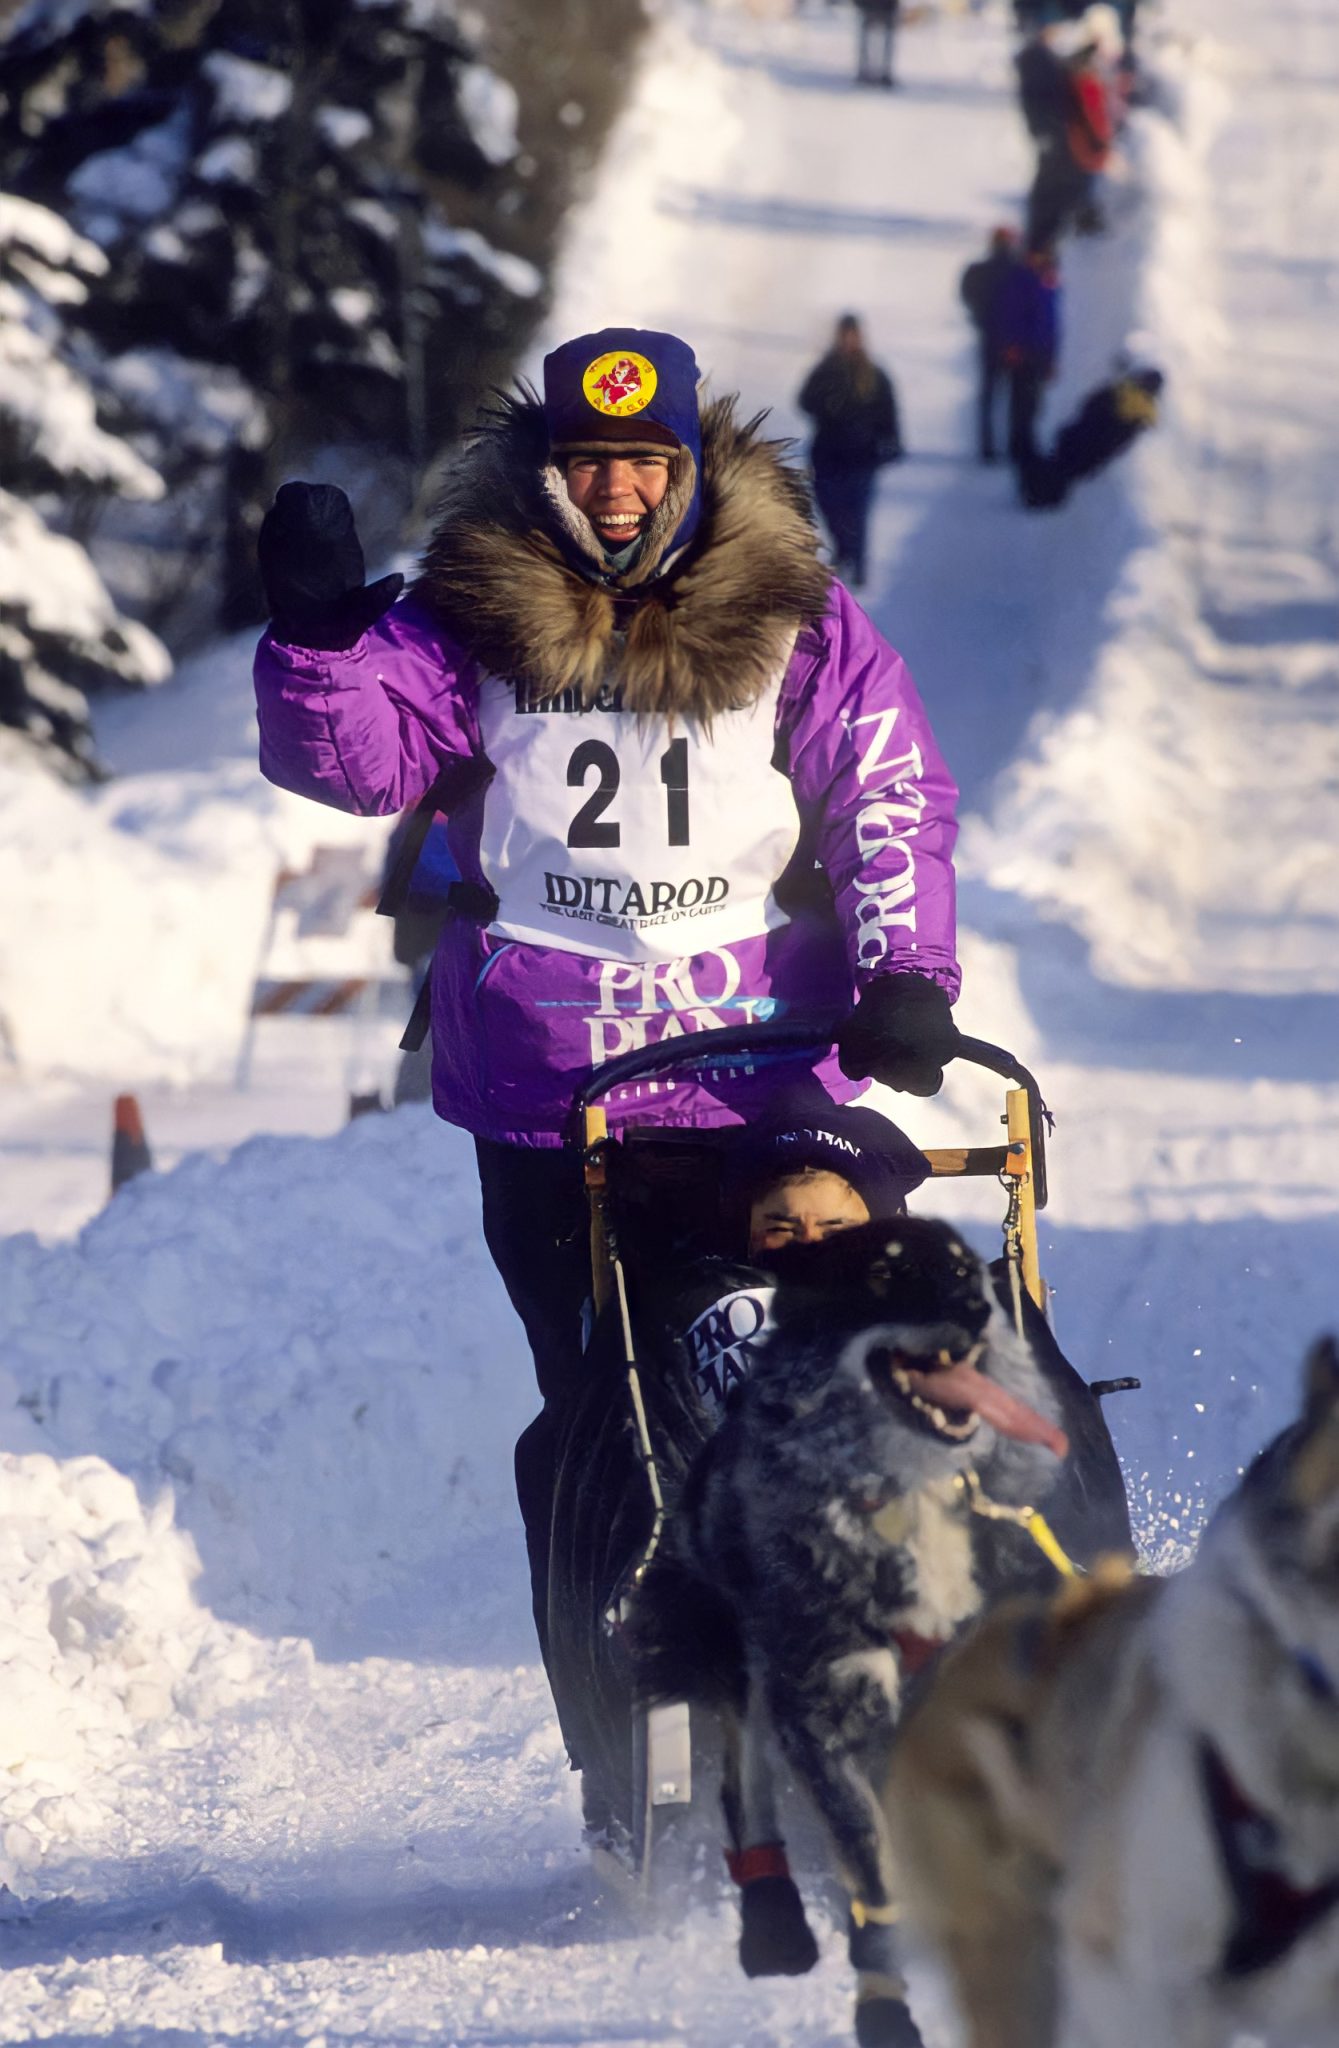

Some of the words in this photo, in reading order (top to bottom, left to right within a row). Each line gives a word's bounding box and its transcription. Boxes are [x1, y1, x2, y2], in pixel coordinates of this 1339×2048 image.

[566, 737, 690, 848] 21
[543, 871, 730, 917] IDITAROD
[593, 946, 742, 1016] PRO
[686, 1295, 765, 1373] PRO
